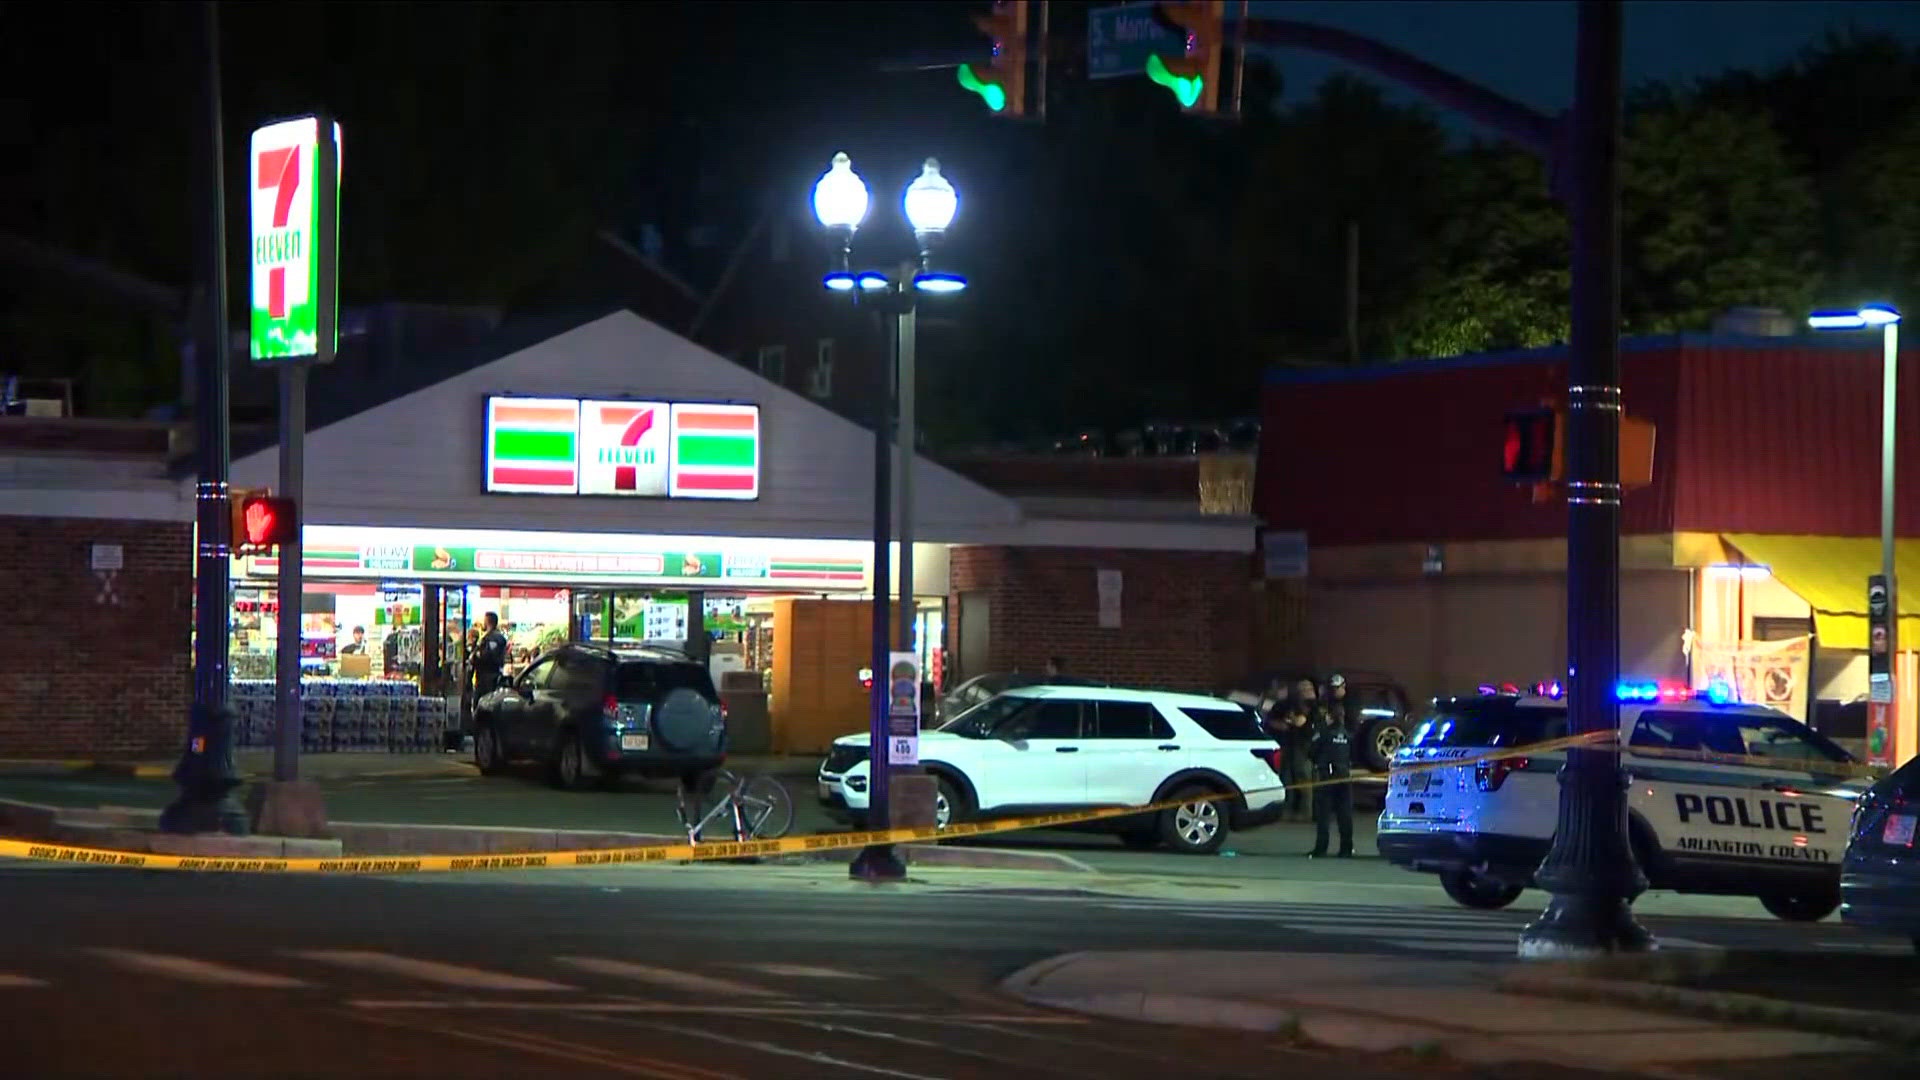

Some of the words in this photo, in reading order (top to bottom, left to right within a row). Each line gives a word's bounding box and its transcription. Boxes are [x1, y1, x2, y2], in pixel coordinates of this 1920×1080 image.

[258, 144, 300, 319] 7
[1675, 793, 1827, 834] POLICE
[1677, 836, 1763, 855] ARLINGTON
[1769, 845, 1831, 862] COUNTY
